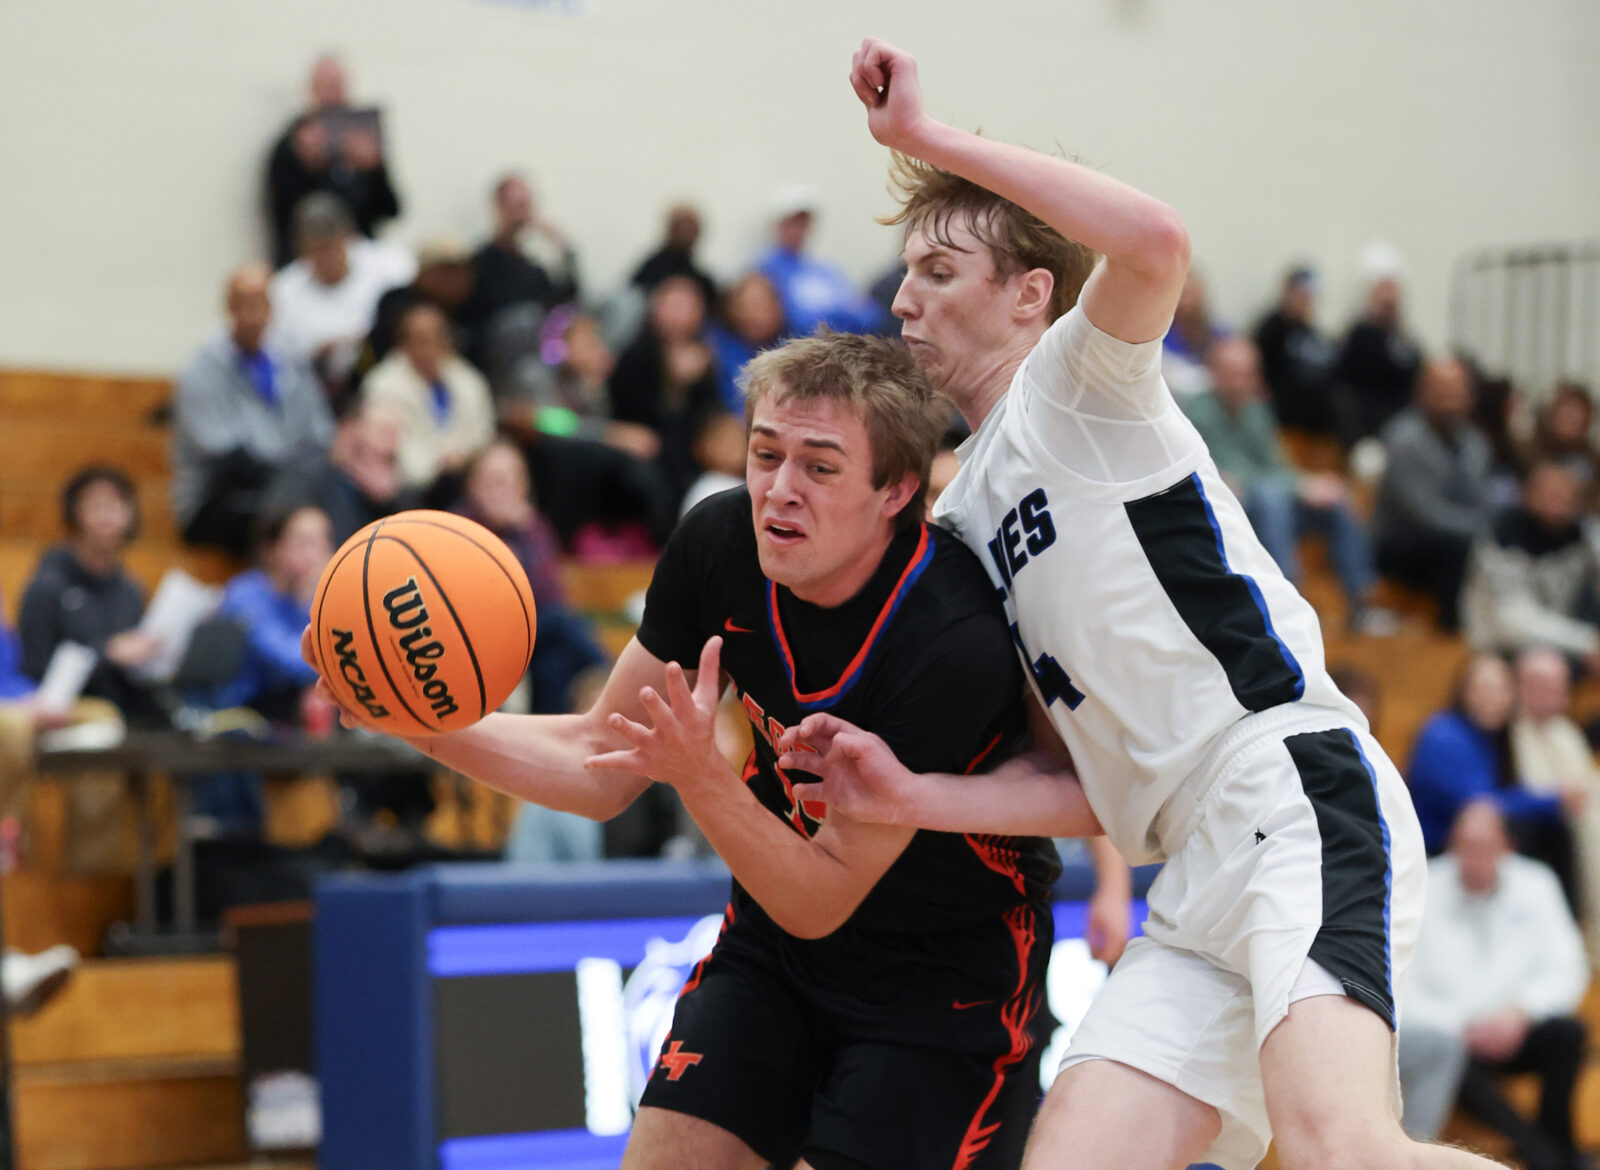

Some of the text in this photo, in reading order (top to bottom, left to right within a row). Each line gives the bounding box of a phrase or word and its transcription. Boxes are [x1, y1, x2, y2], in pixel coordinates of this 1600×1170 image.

[988, 487, 1056, 595] VES
[331, 627, 392, 719] NCAA
[382, 574, 459, 721] Wilson
